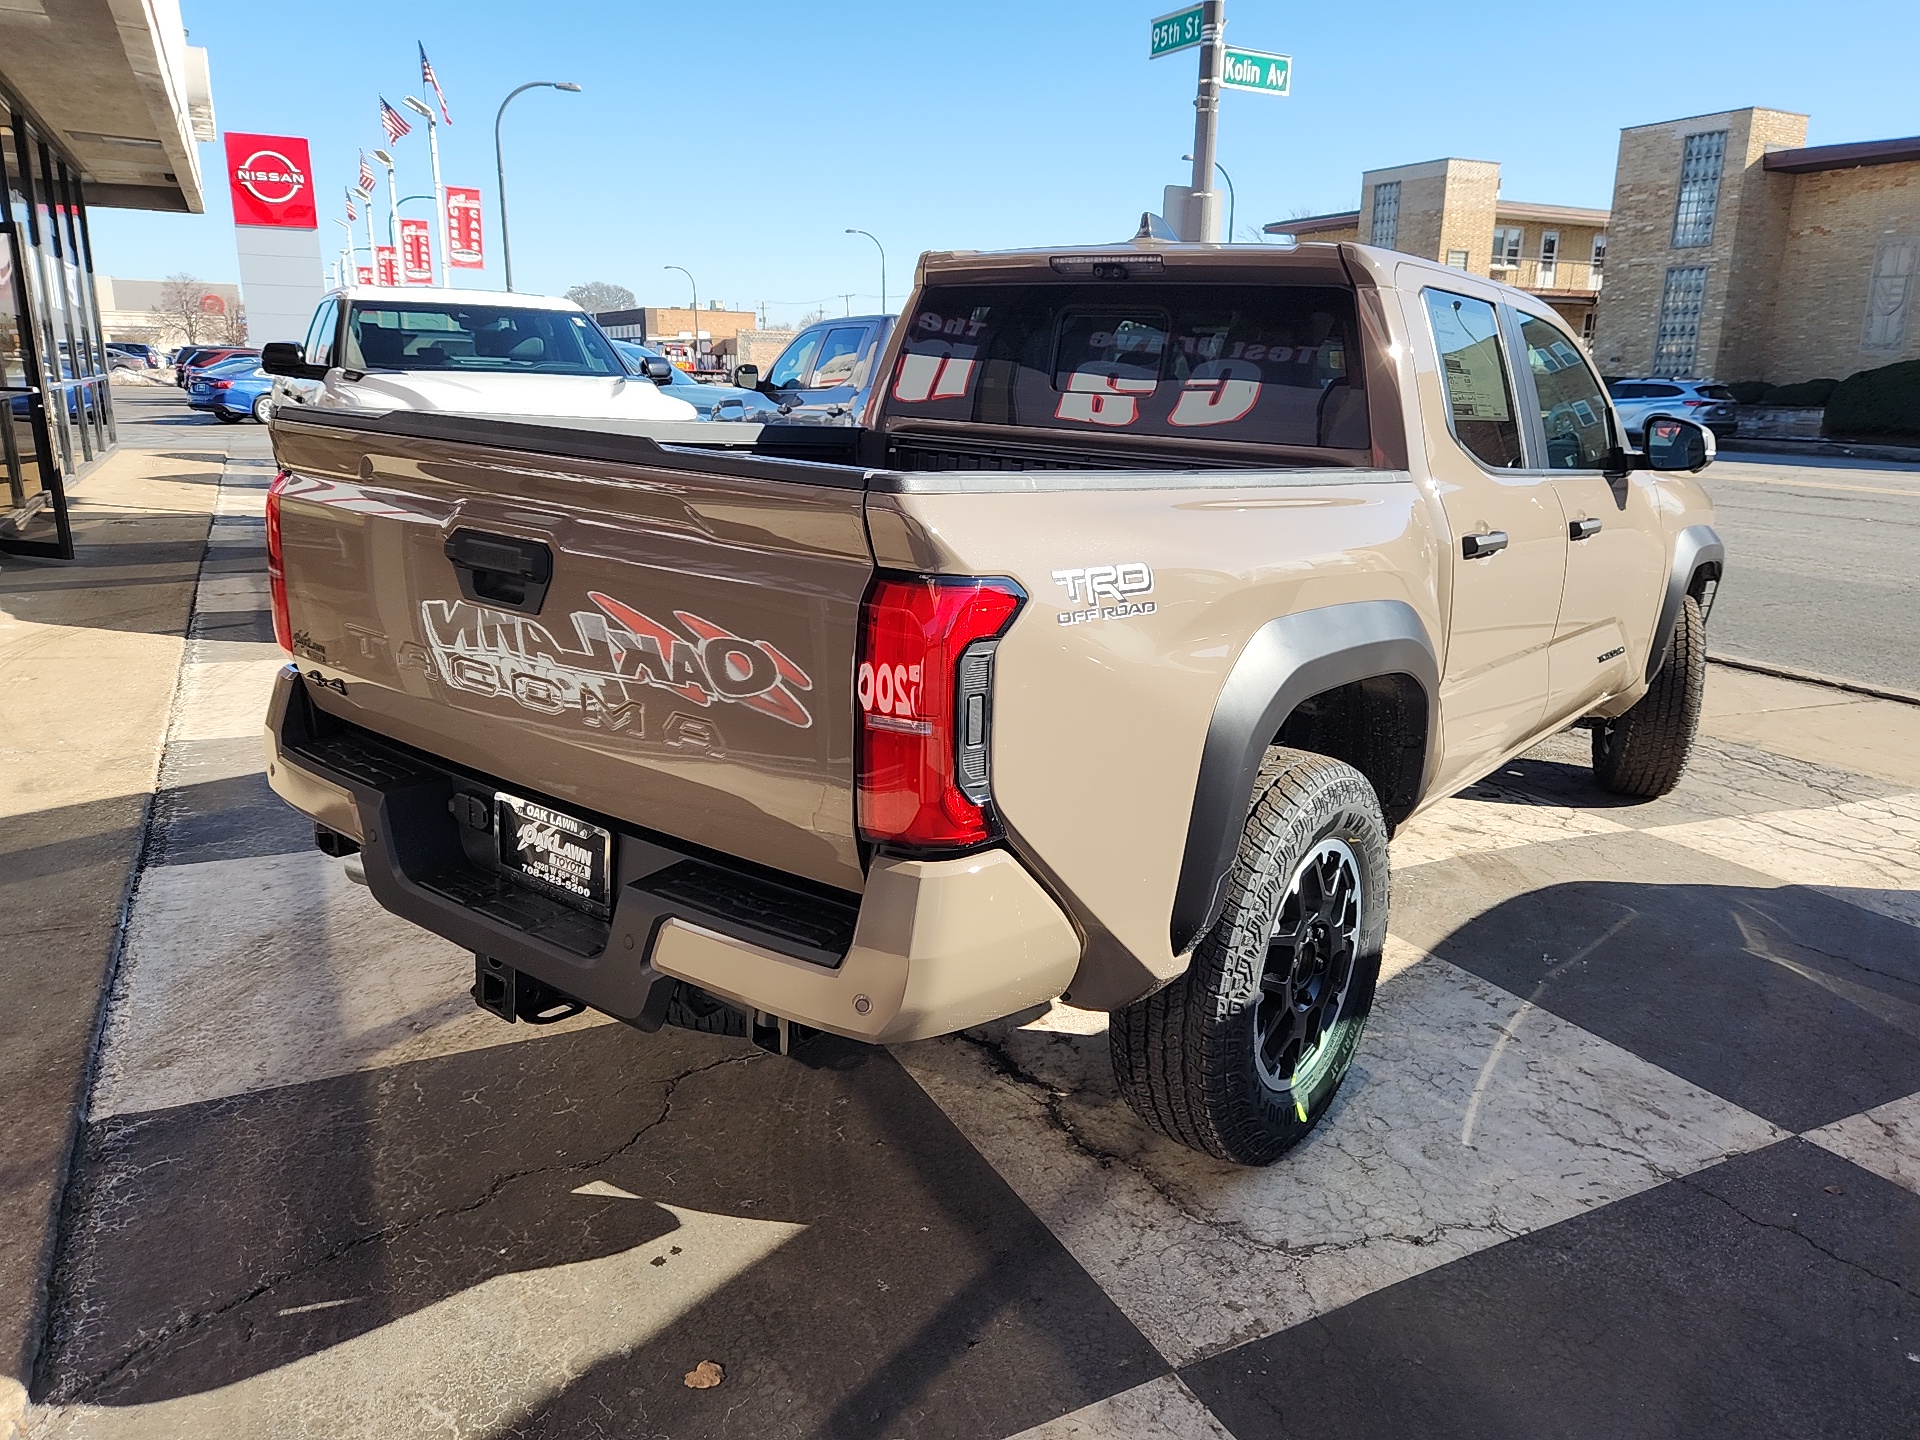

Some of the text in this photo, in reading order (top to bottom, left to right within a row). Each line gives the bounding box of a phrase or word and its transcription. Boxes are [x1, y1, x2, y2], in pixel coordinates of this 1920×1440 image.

[1153, 14, 1200, 49] 95th St
[1225, 56, 1286, 88] Kolin Av
[238, 170, 305, 183] NISSAN
[449, 207, 462, 249] USED
[469, 209, 480, 251] CARS
[1051, 562, 1154, 607] TRD
[1057, 601, 1157, 626] OFF ROAD
[526, 805, 578, 833] OAK LAWN
[521, 863, 591, 898] 708-423-5200
[549, 866, 557, 876] W
[554, 854, 588, 878] TOYOTA
